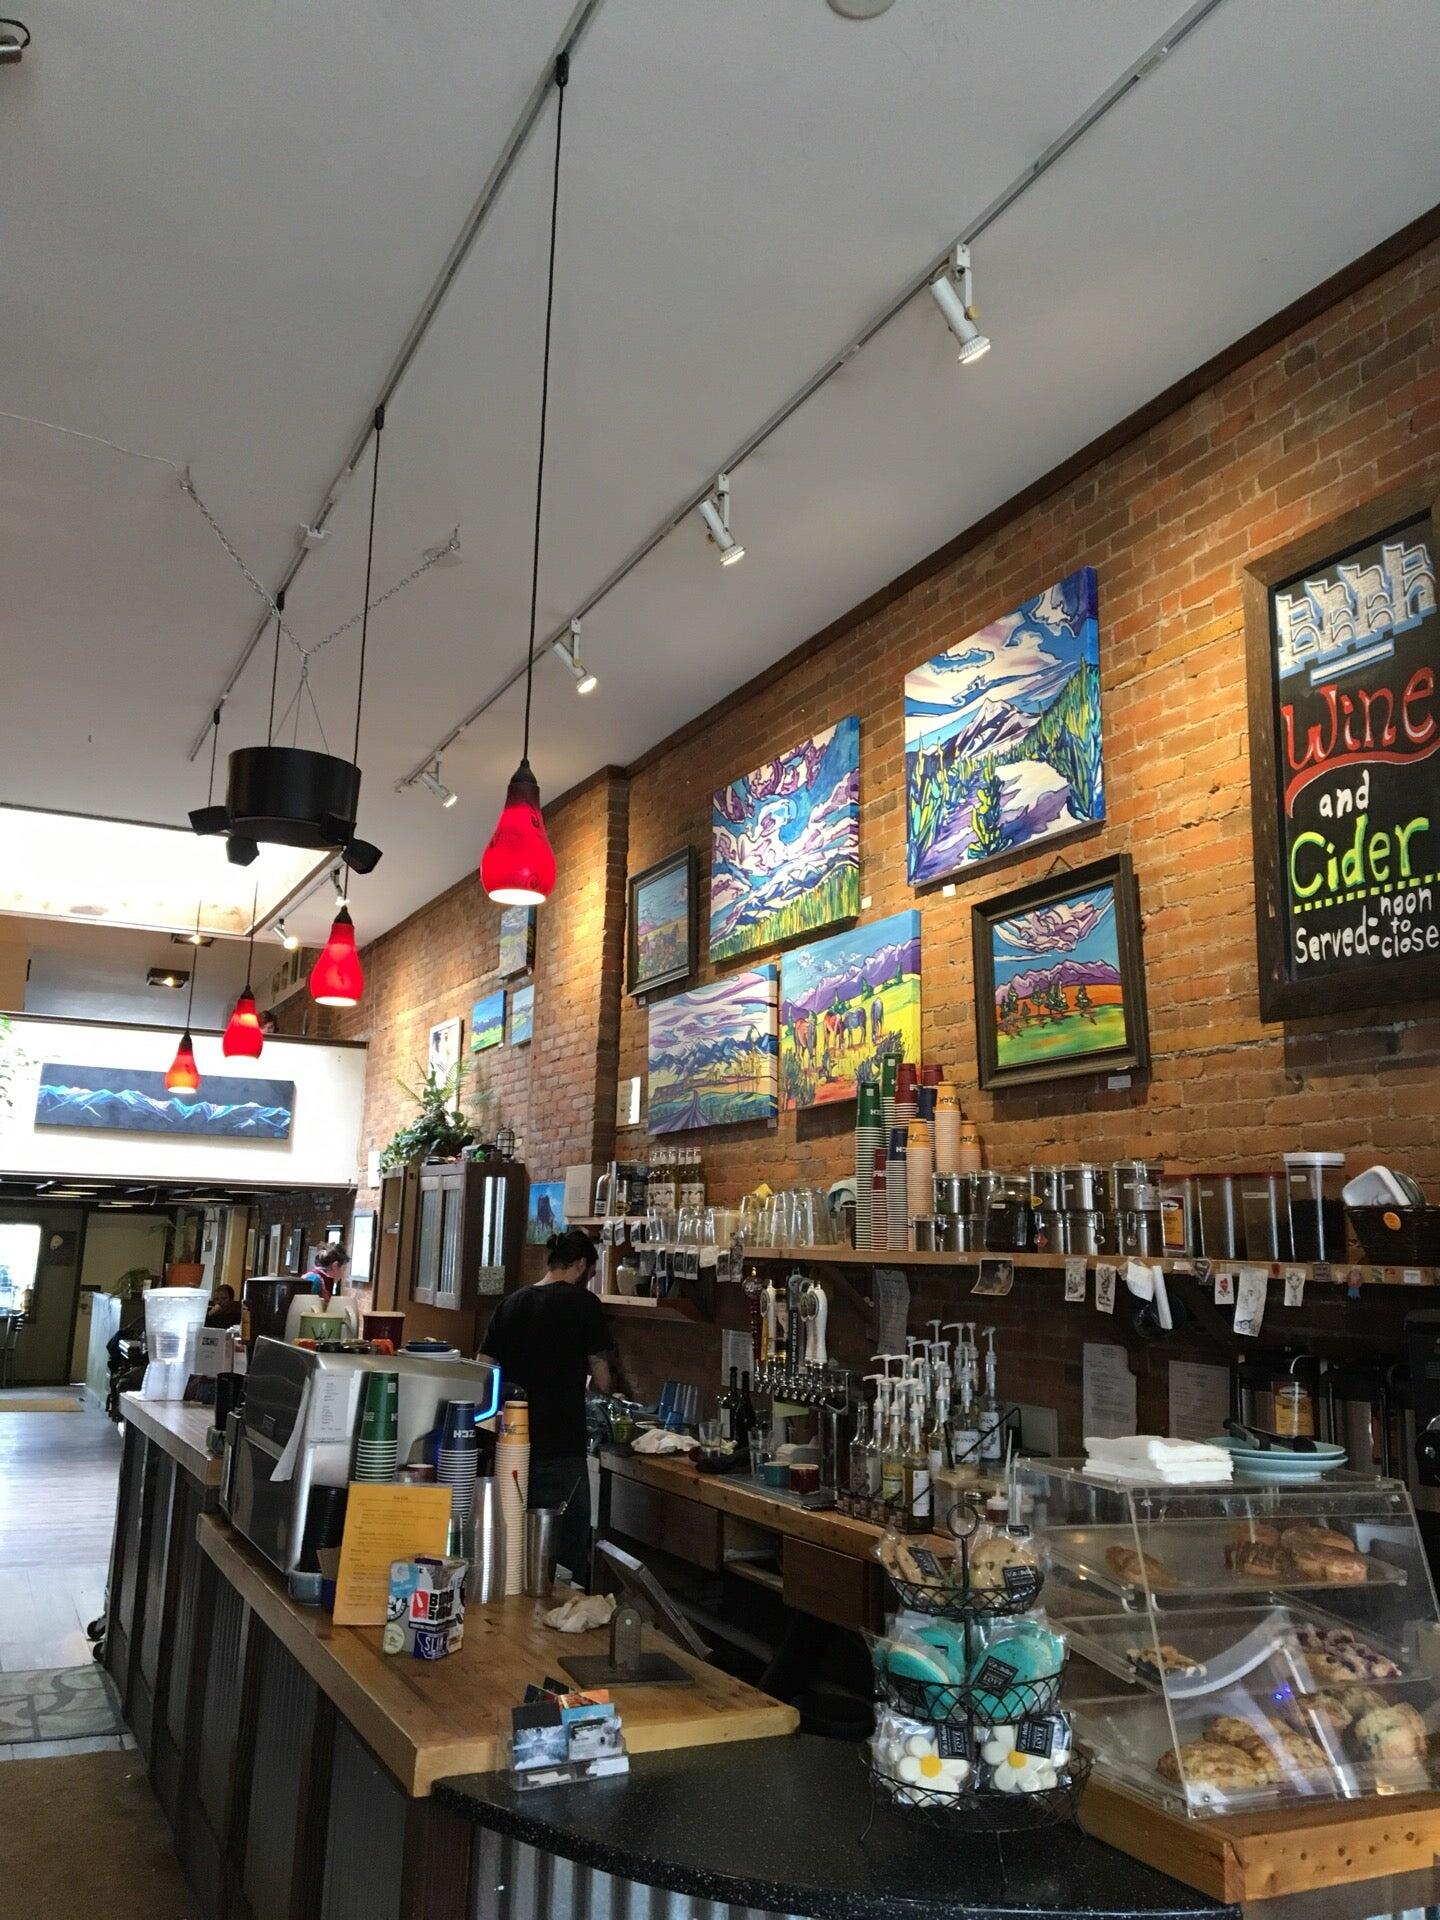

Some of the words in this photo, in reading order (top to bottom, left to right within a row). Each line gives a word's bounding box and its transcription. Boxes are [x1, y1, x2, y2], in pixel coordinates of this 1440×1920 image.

[1281, 667, 1435, 770] Wine
[1319, 769, 1370, 819] and
[1291, 813, 1429, 897] Cider
[1380, 887, 1432, 916] noon
[1381, 925, 1440, 958] close
[1390, 916, 1411, 934] to
